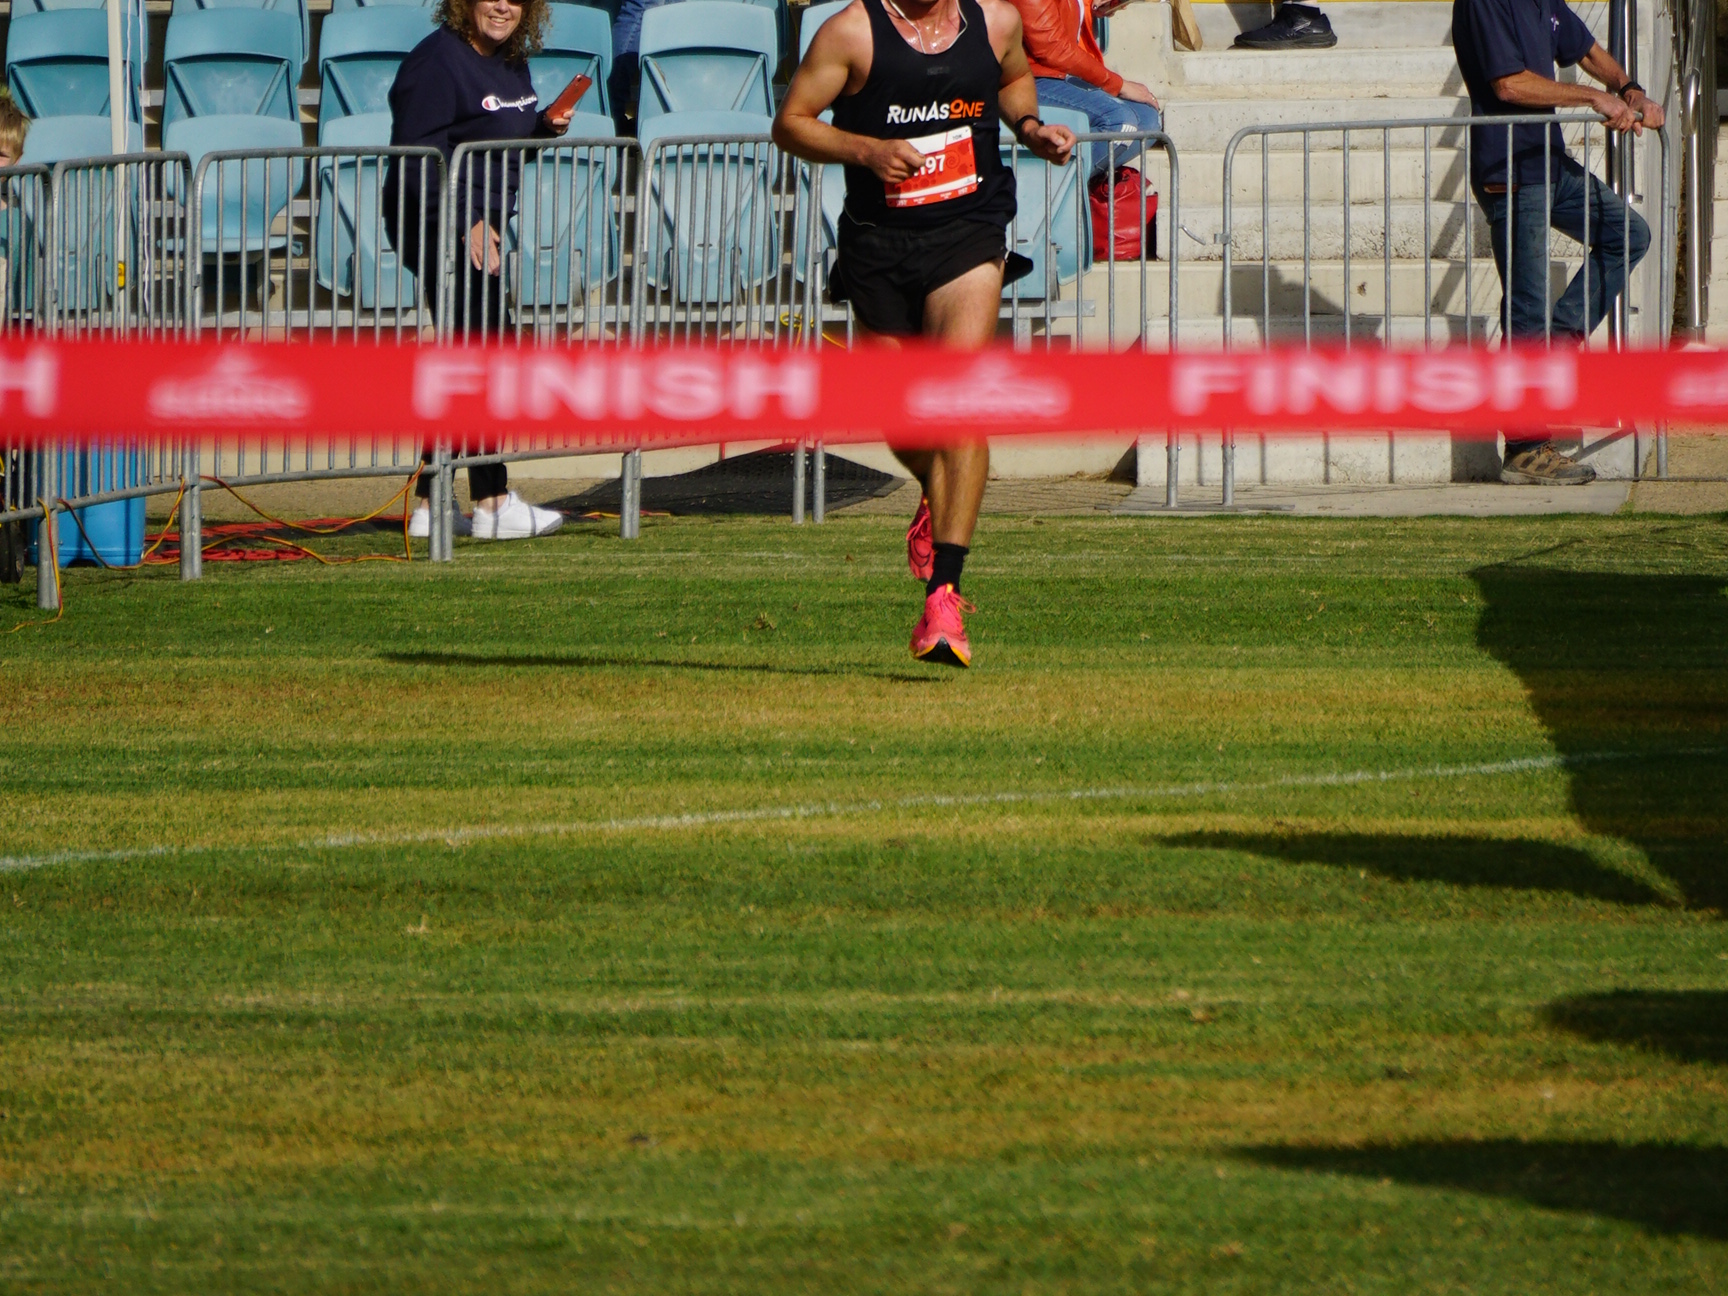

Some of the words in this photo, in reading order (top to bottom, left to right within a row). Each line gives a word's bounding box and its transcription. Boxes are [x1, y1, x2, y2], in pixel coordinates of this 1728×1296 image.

[914, 154, 946, 177] 97
[414, 349, 821, 420] FINISH
[1171, 347, 1577, 416] FINISH
